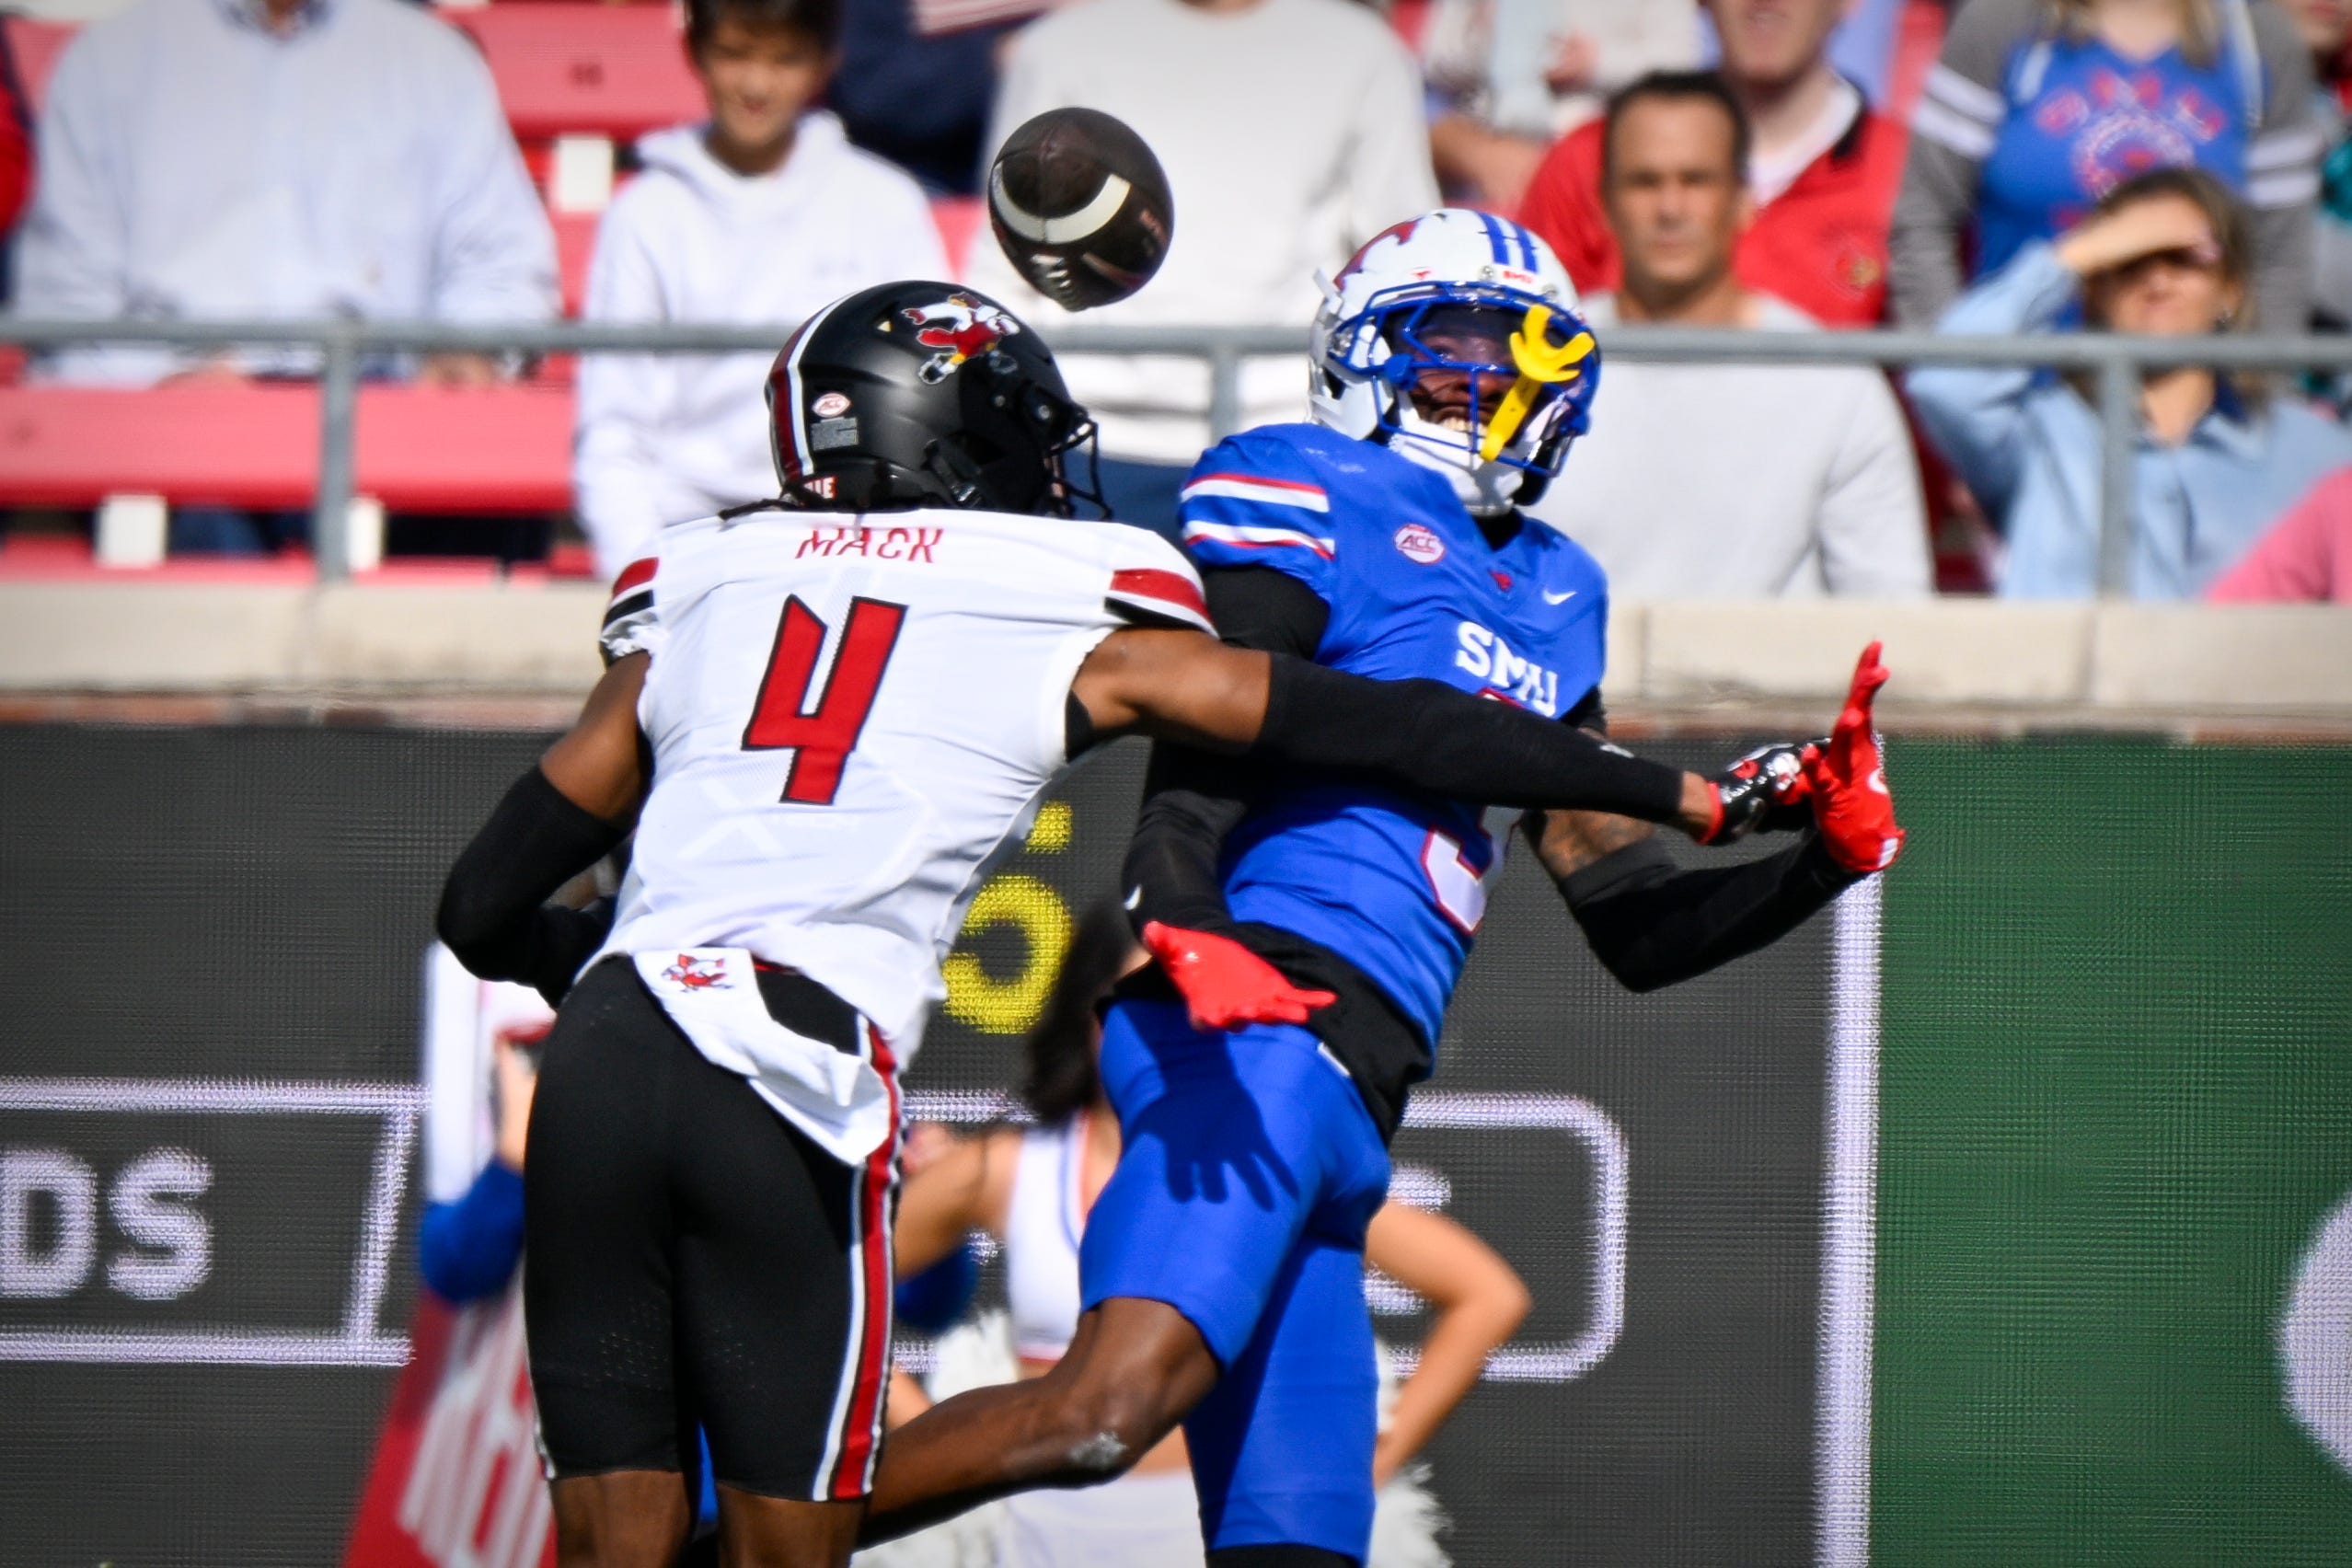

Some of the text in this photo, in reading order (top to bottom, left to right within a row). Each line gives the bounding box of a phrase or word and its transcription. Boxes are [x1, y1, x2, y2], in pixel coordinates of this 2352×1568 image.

[795, 525, 944, 563] MACK
[1398, 534, 1436, 553] ACC
[740, 594, 909, 806] 4
